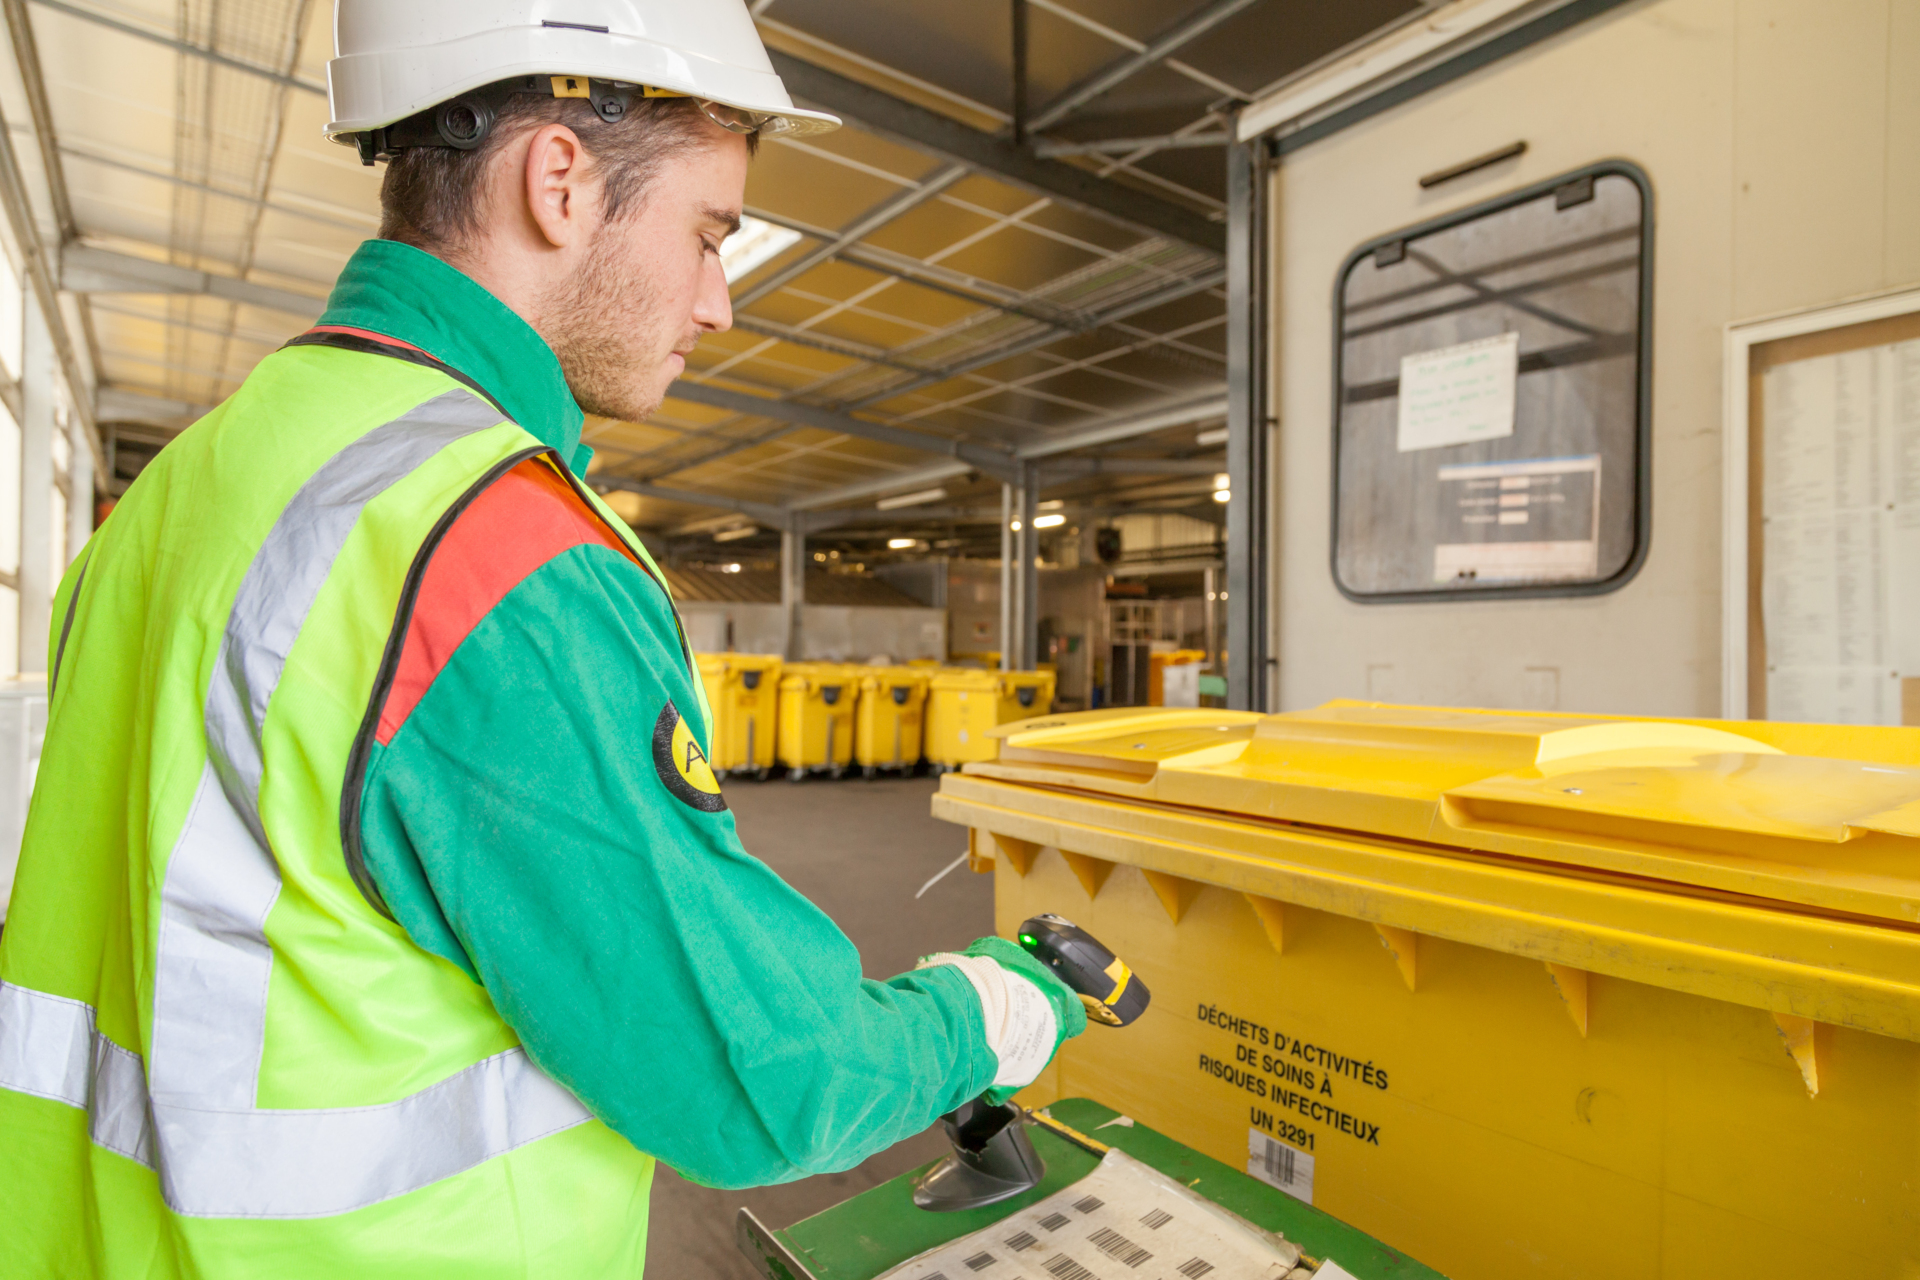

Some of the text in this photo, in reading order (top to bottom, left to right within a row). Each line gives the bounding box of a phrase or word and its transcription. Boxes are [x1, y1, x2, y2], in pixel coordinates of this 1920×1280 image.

[686, 741, 708, 772] A
[1197, 1003, 1389, 1090] DÉCHETS D'ACTIVITÉS
[1236, 1043, 1333, 1098] DE SOINS À
[1199, 1053, 1380, 1146] RISQUES INFECTIEUX
[1250, 1106, 1315, 1151] UN 3291
